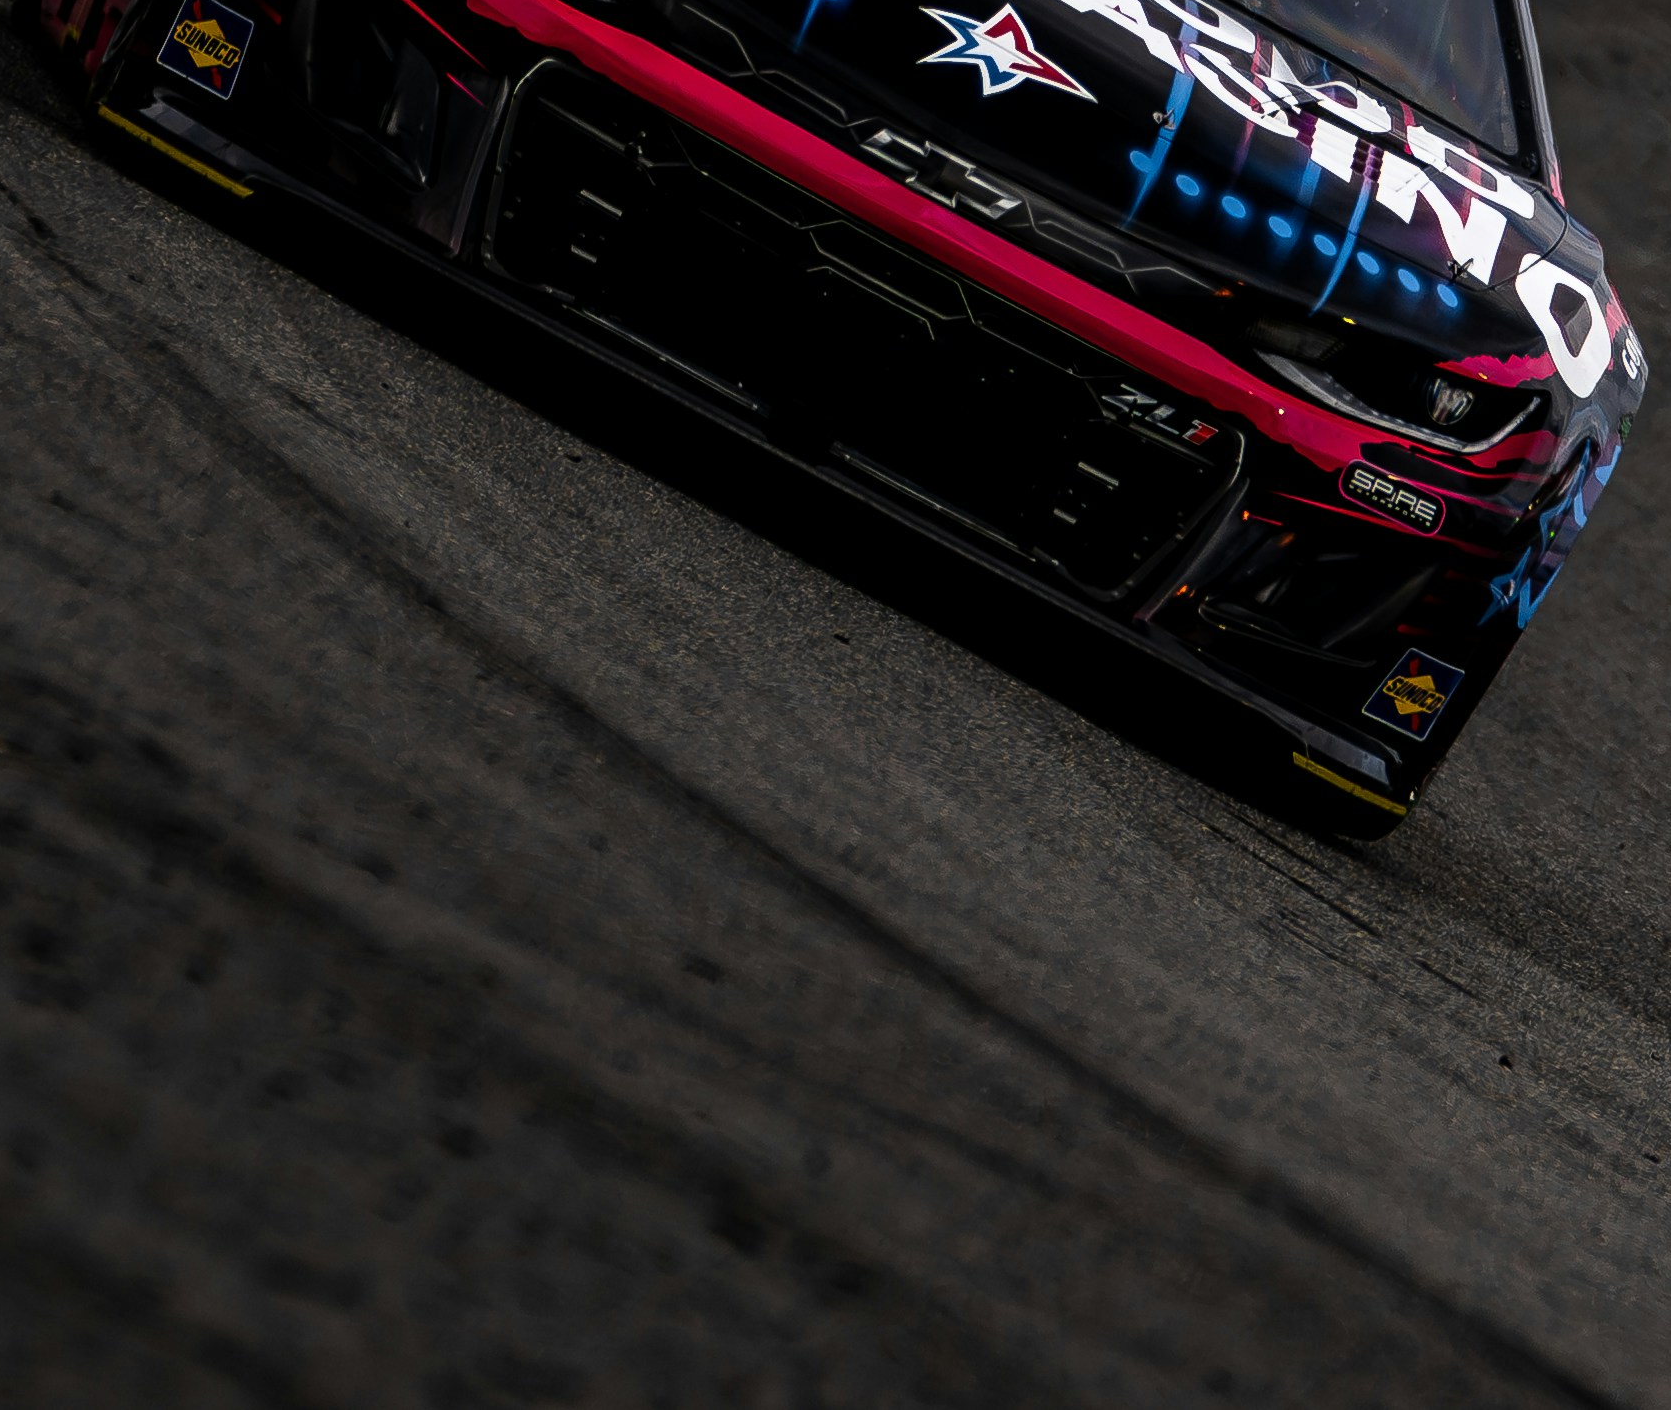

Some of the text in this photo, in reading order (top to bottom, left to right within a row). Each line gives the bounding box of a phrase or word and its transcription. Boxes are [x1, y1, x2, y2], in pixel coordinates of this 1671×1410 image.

[175, 21, 240, 68] SUNOCO
[1101, 383, 1219, 446] ZL1
[1385, 676, 1444, 712] SUNOCO
